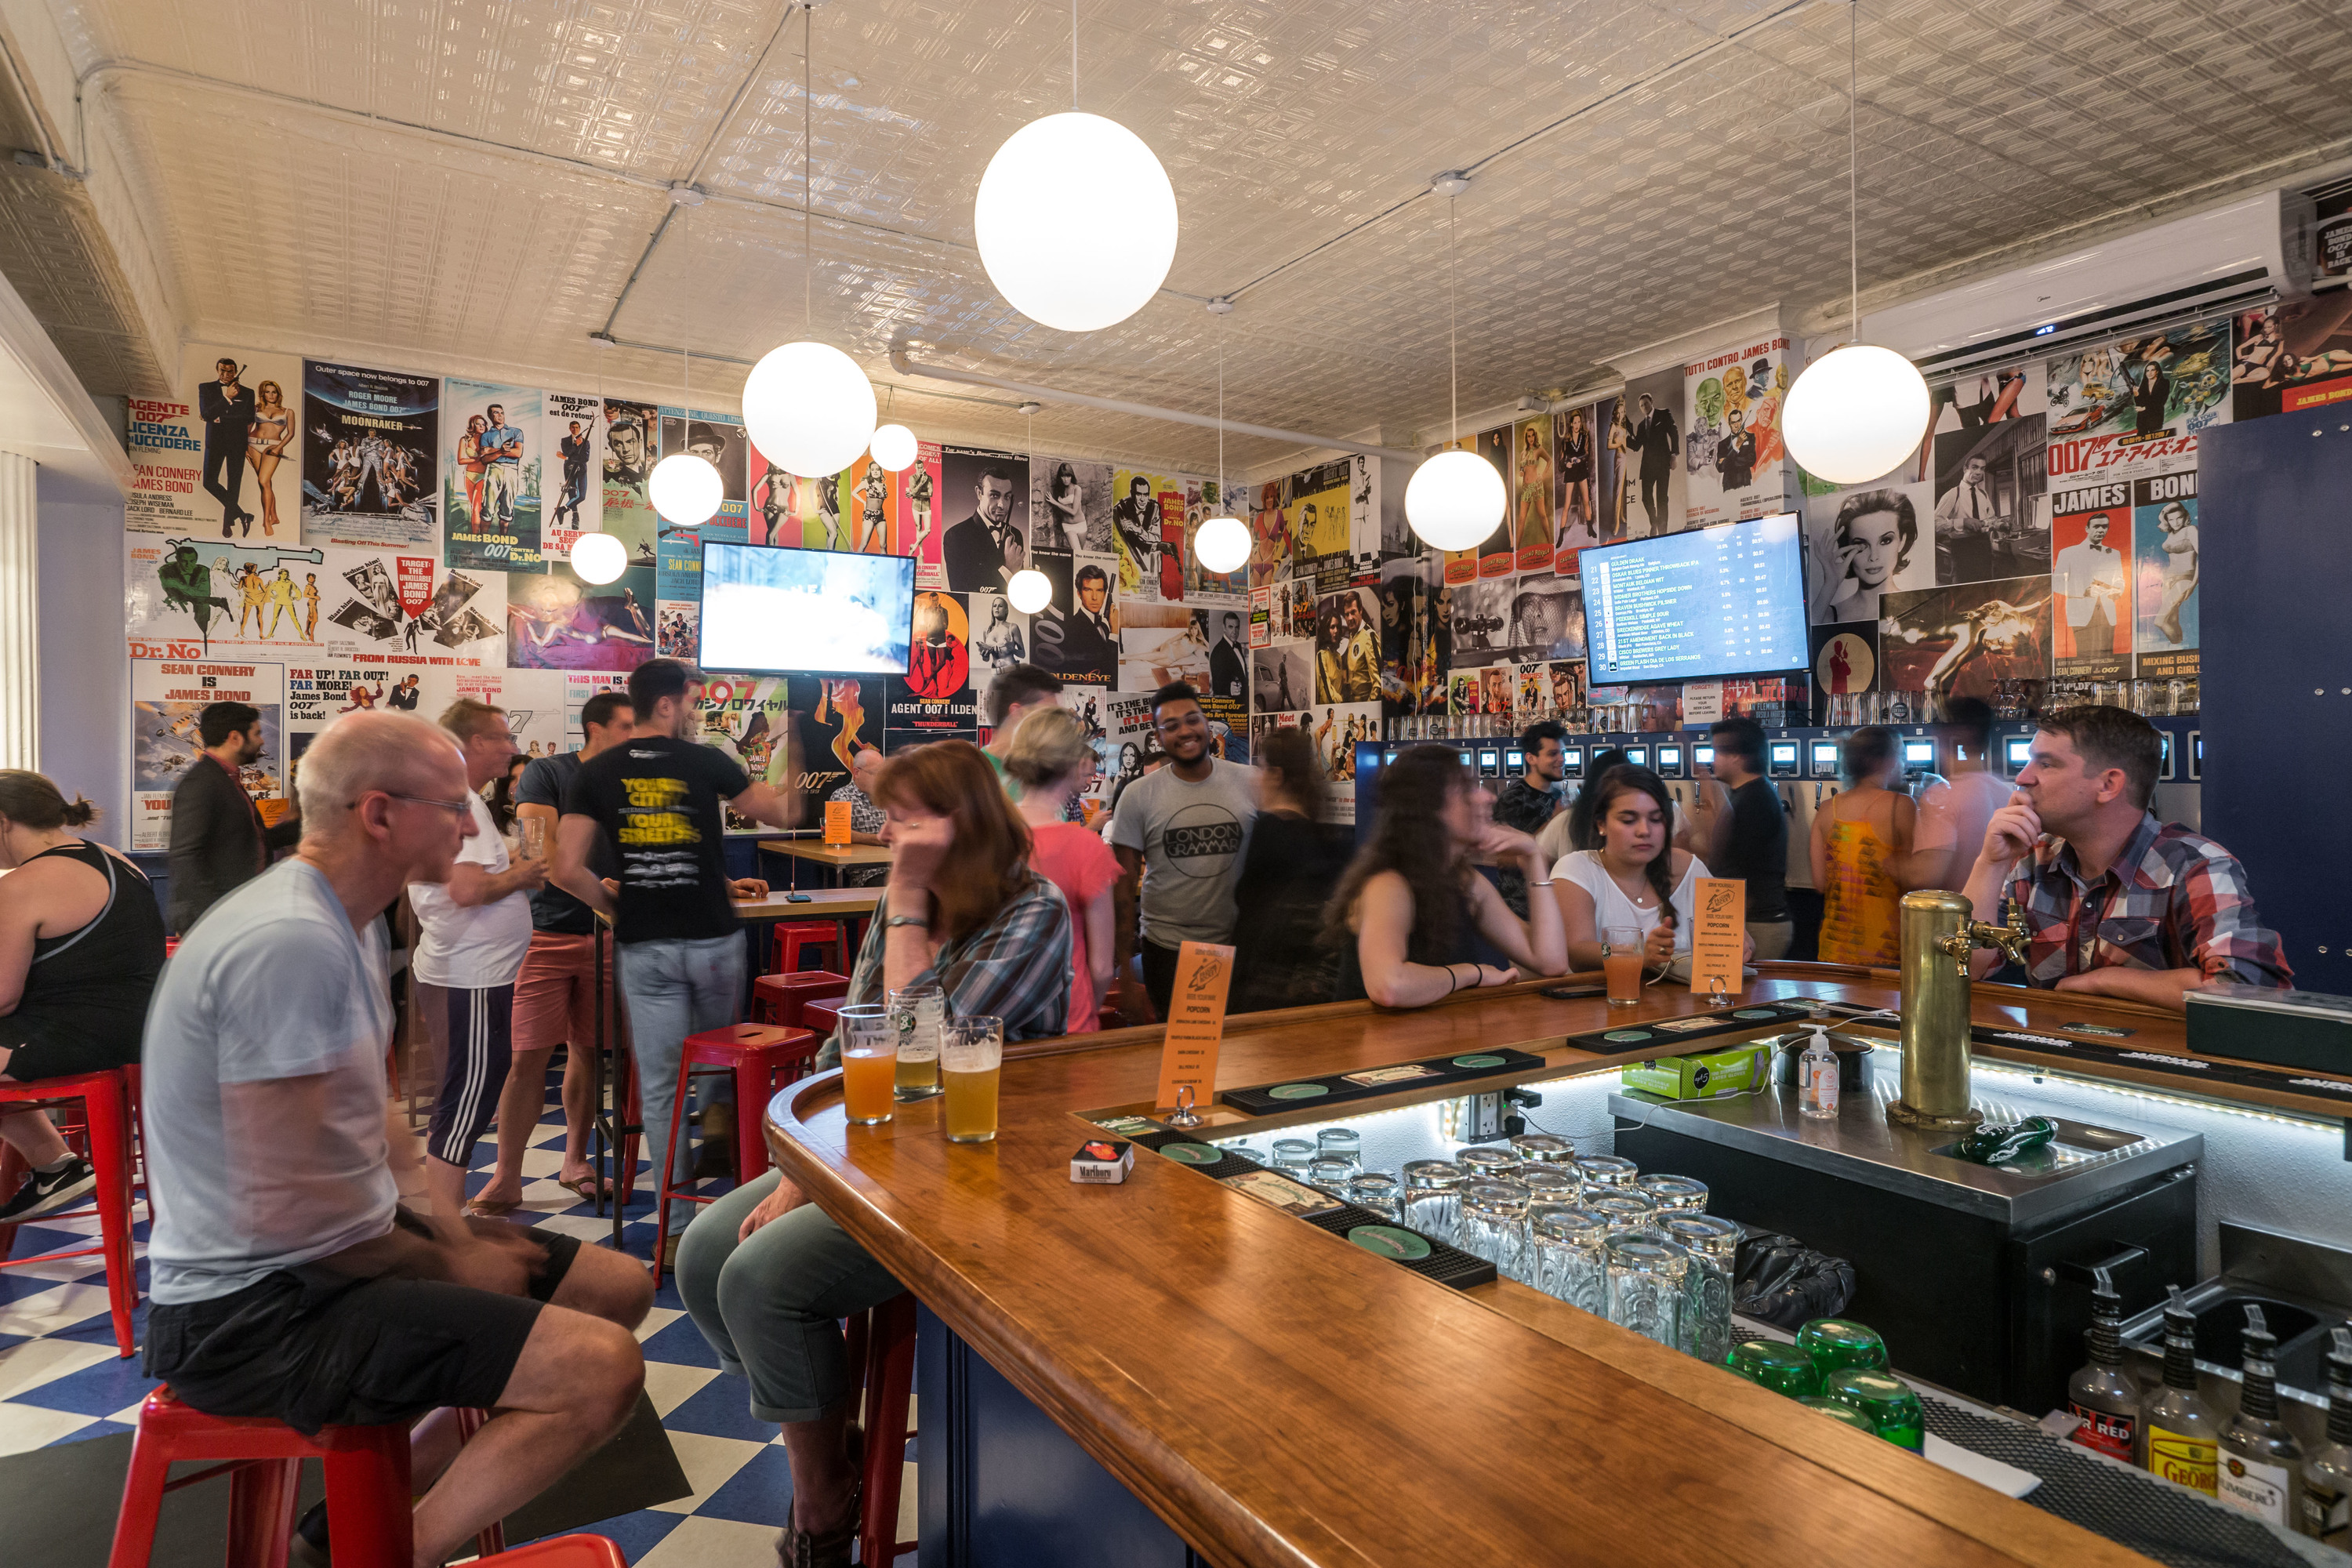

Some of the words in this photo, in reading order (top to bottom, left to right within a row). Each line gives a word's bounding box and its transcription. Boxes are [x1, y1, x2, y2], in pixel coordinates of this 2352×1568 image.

[1684, 362, 1705, 376] TUTTI
[1708, 351, 1739, 370] CONTRO
[1741, 343, 1769, 361] JAMES
[1772, 338, 1791, 351] BOND
[315, 365, 336, 375] Outer
[338, 369, 360, 378] space
[379, 374, 408, 386] belongs
[349, 390, 372, 401] ROGER
[374, 394, 397, 404] MOORE
[550, 394, 576, 405] JAMES
[578, 397, 599, 408] BOND
[2296, 393, 2326, 406] JAMES
[2328, 388, 2352, 399] BOND
[129, 398, 190, 416] AGENTE
[343, 399, 367, 409] JAMES
[369, 402, 388, 412] BOND
[341, 414, 403, 431] MOONRAKER
[571, 412, 593, 420] retour
[135, 434, 201, 452] UCCIDERE
[156, 466, 202, 481] CONNERY
[165, 480, 194, 494] BOND
[602, 488, 630, 497] 007
[2151, 474, 2198, 501] BON
[2054, 482, 2125, 514] JAMES
[721, 503, 743, 514] 007
[452, 532, 481, 543] JAMES
[483, 533, 518, 545] BOND
[485, 543, 511, 558] 007
[401, 559, 431, 568] TARGET:
[408, 567, 423, 575] THE
[399, 575, 432, 583] UNKILLABLE
[403, 583, 429, 591] JAMES
[404, 590, 427, 599] BOND
[129, 643, 165, 659] Dr.
[168, 644, 201, 659] No
[353, 653, 384, 663] FROM
[387, 655, 427, 665] RUSSIA
[428, 656, 454, 666] WITH
[456, 657, 481, 666] LOVE
[2142, 656, 2174, 666] MIXING
[161, 663, 194, 675] SEAN
[197, 665, 256, 677] CONNERY
[289, 669, 314, 680] FAR
[315, 670, 336, 681] UP!
[339, 670, 361, 681] FAR
[363, 670, 389, 681] OUT!
[2056, 667, 2068, 677] SEAN
[2069, 666, 2092, 675] CONNERY
[2156, 667, 2174, 676] AND
[201, 676, 217, 688] IS
[289, 680, 313, 691] FAR
[315, 681, 352, 691] MORE!
[568, 674, 590, 684] THIS
[592, 675, 612, 684] MAN
[612, 676, 622, 684] IS
[165, 689, 210, 701] JAMES
[213, 690, 252, 702] BOND
[290, 691, 321, 701] James
[322, 692, 347, 701] Bond
[569, 689, 590, 699] FIRST
[891, 702, 923, 713] AGENT
[924, 704, 943, 714] 007
[951, 705, 978, 715] ILDEN
[1107, 702, 1124, 713] IT'S
[1125, 699, 1142, 709] THE
[1116, 709, 1131, 719] IT'S
[1131, 706, 1149, 717] THE
[1488, 701, 1508, 713] 007
[290, 711, 299, 720] is
[300, 710, 326, 720] back!
[1123, 716, 1142, 726] IT'S
[1278, 713, 1295, 722] Meet
[1118, 724, 1138, 735] AND
[749, 754, 766, 763] JAMES
[144, 799, 172, 811] YOU
[1165, 823, 1240, 844] LONDON
[1167, 838, 1239, 857] GRAMMAR
[1186, 1005, 1210, 1014] POPCORN
[1079, 1165, 1112, 1178] Marlboro
[2097, 1422, 2130, 1440] RED
